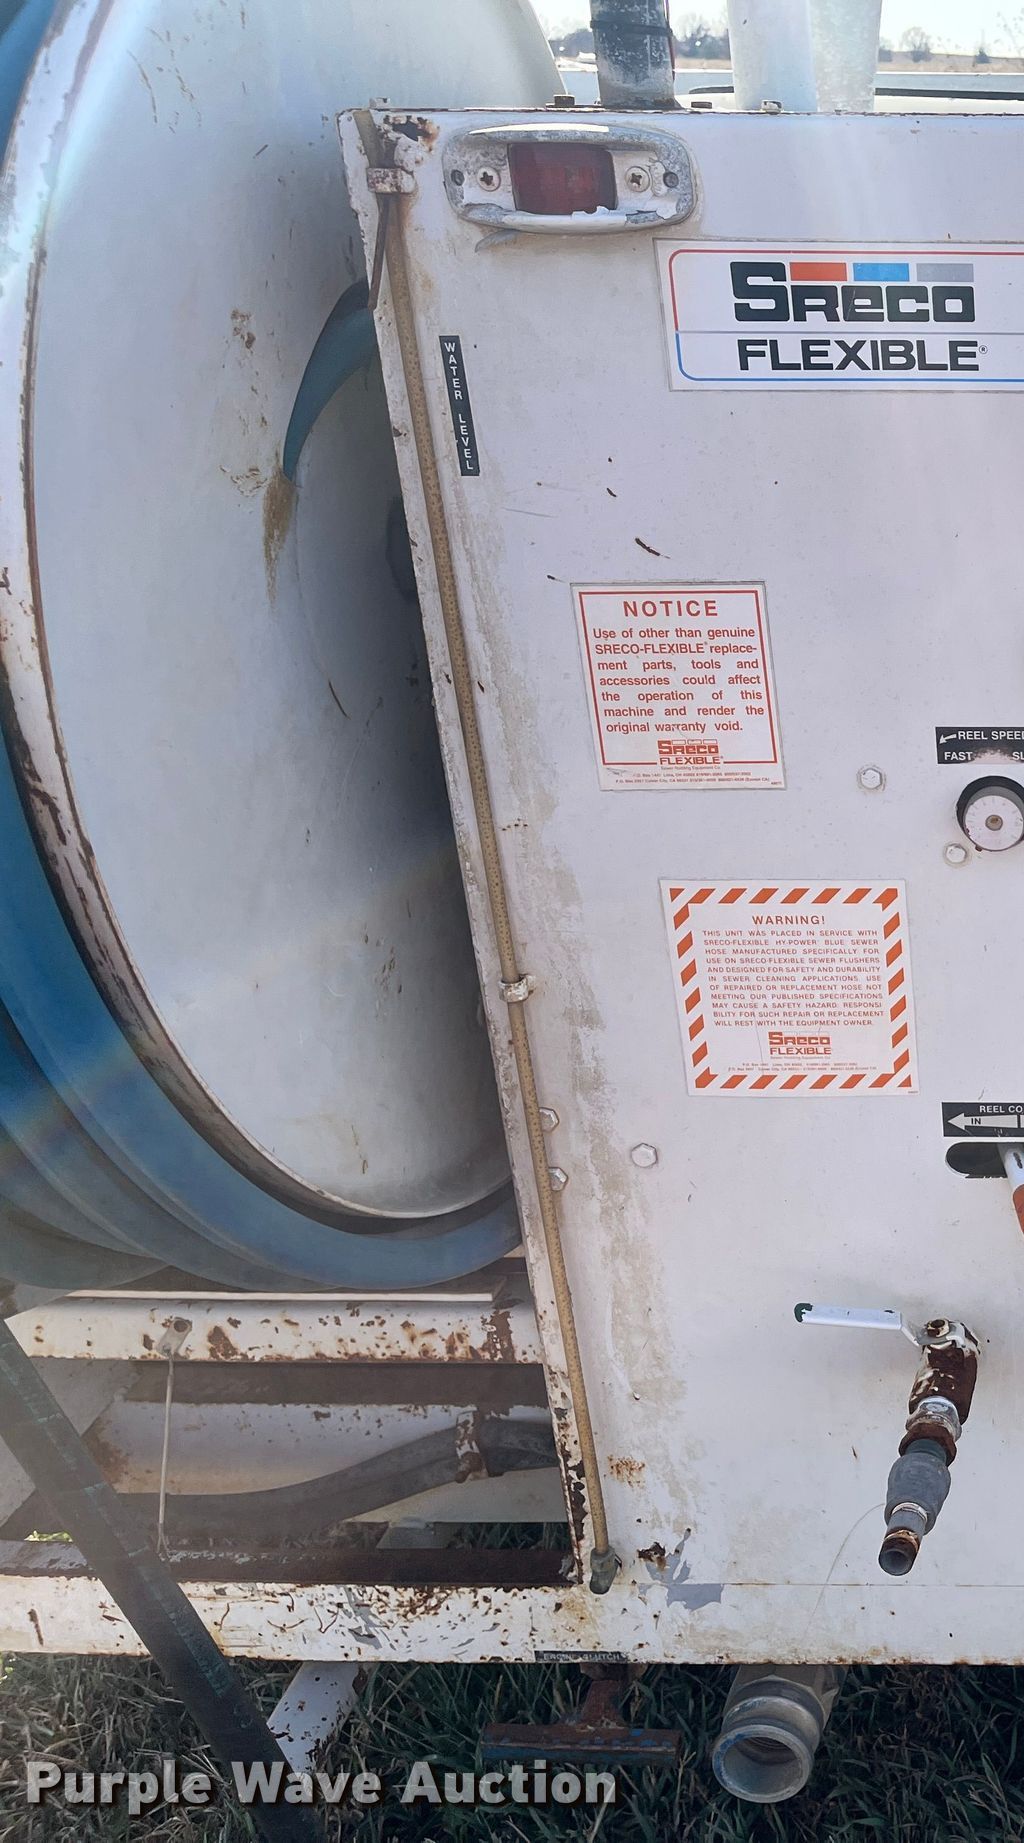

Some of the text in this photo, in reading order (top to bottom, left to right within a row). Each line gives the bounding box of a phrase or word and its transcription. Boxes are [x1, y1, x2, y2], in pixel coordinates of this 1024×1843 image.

[444, 342, 474, 470] WATER LEVEL
[623, 600, 718, 617] NOTICE
[593, 626, 755, 640] Use of other than genuine
[710, 643, 757, 656] replace-
[597, 658, 759, 672] ment parts, tools and
[599, 674, 761, 686] accessories could affect
[601, 690, 762, 703] the operation of this
[604, 705, 764, 717] machine and render the
[606, 720, 743, 735] original warranty void.
[958, 731, 988, 740] REEL
[944, 752, 973, 760] FAST
[752, 915, 825, 925] WARNING!
[770, 1046, 832, 1055] FLEXIBLE
[979, 1105, 1005, 1113] REEL
[971, 1117, 981, 1125] IN
